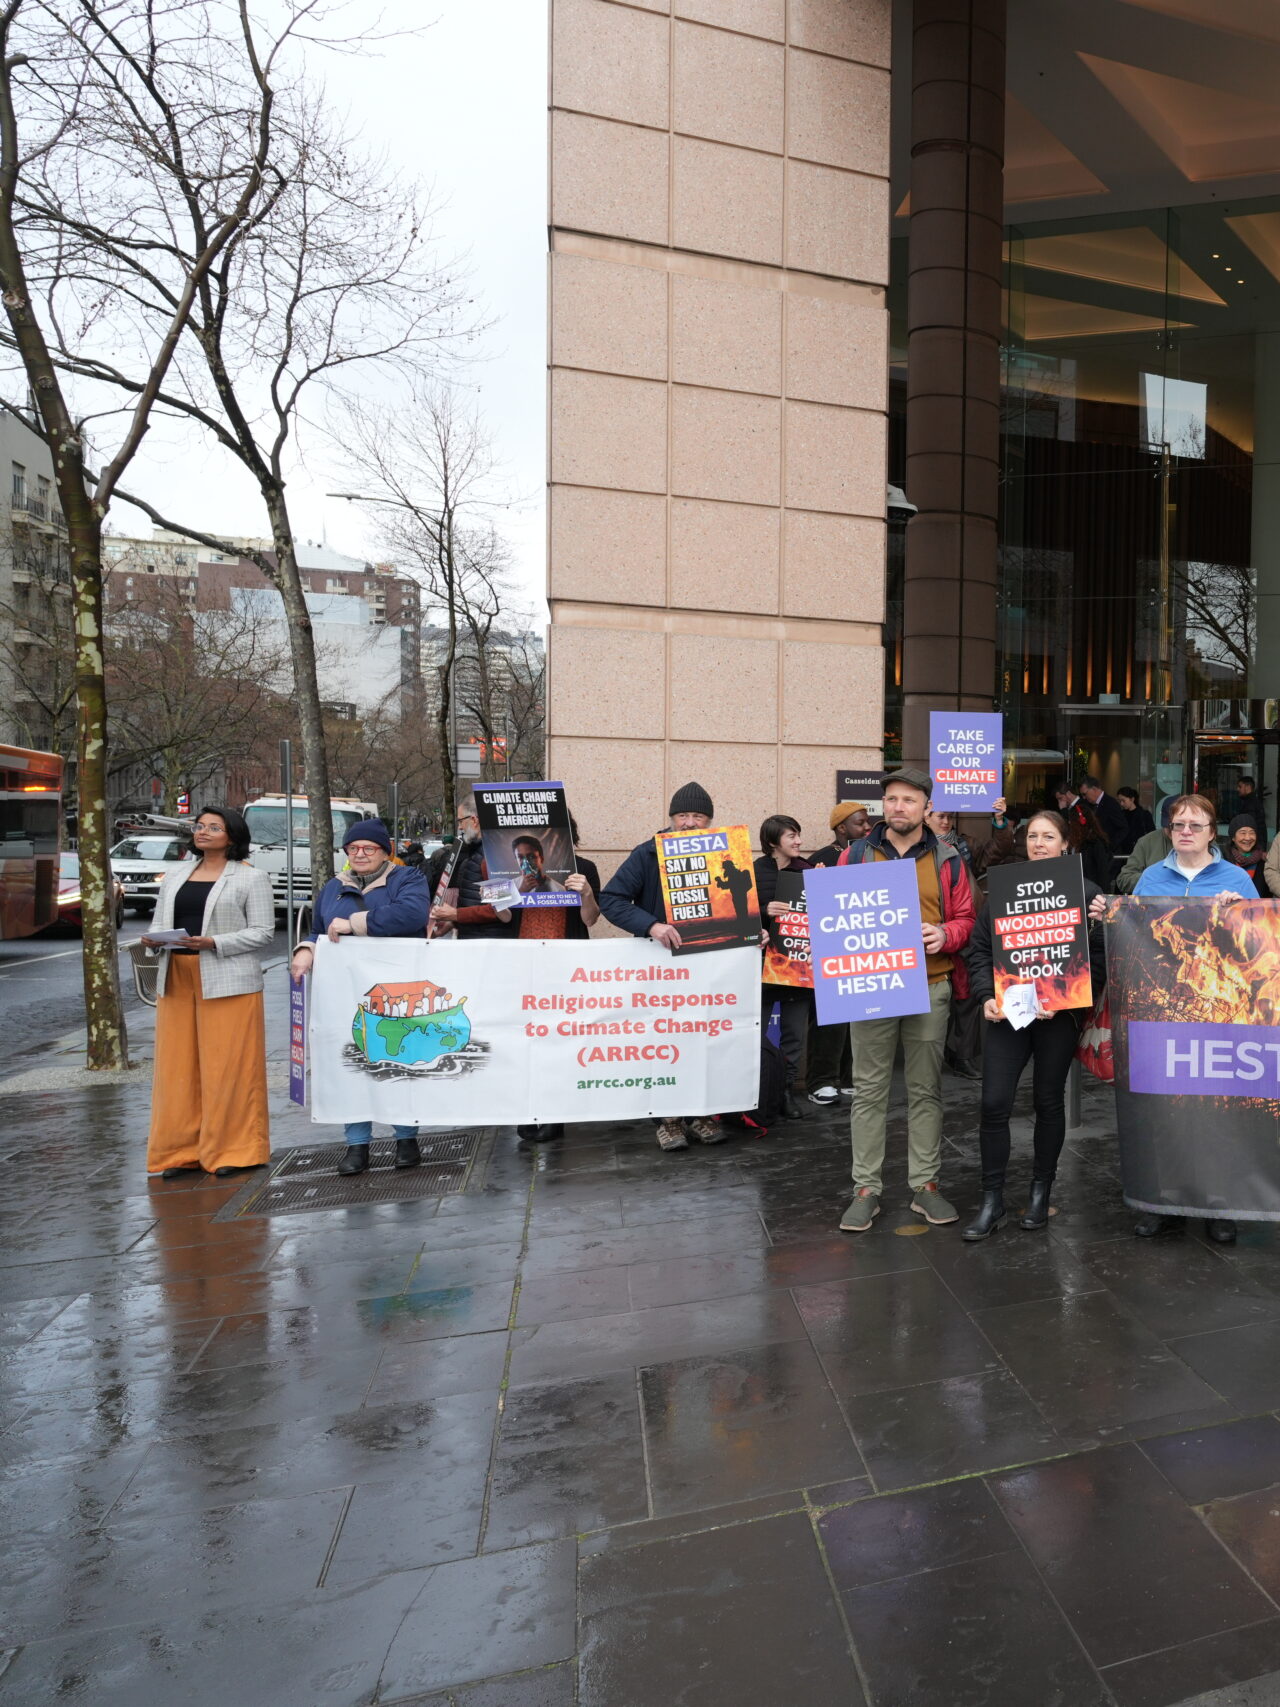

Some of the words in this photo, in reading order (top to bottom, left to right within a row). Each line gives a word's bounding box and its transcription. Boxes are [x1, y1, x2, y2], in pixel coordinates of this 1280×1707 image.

[948, 730, 984, 741] TAKE
[937, 743, 973, 754] CARE
[976, 744, 995, 754] OF
[951, 757, 980, 768] OUR
[936, 770, 996, 781] CLIMATE
[483, 793, 521, 804] CLIMATE
[523, 792, 557, 803] CHANGE
[944, 784, 987, 795] HESTA
[496, 804, 506, 815] IS
[508, 804, 514, 814] A
[515, 803, 548, 814] HEALTH
[498, 815, 549, 826] EMERGENCY
[664, 835, 726, 855] HESTA
[666, 859, 687, 873] SAY
[690, 857, 706, 871] NO
[668, 875, 682, 889] TO
[685, 871, 709, 887] NEW
[1017, 880, 1054, 896] STOP
[670, 889, 708, 905] FOSSIL
[834, 889, 890, 910] TAKE
[1006, 895, 1067, 915] LETTING
[673, 904, 709, 921] FUELS!
[820, 912, 876, 933] CARE
[880, 908, 909, 926] OF
[997, 910, 1078, 932] WOODSIDE
[780, 925, 790, 935] &
[1004, 935, 1014, 948] &
[1016, 927, 1074, 947] SANTOS
[844, 932, 890, 951] OUR
[823, 950, 914, 975] CLIMATE
[1010, 949, 1039, 964] OFF
[1041, 944, 1070, 960] THE
[570, 966, 690, 983] Australian
[1019, 962, 1063, 979] HOOK
[837, 973, 904, 995] HESTA
[522, 994, 623, 1014] Religious
[631, 993, 737, 1012] Response
[525, 1022, 549, 1037] to
[556, 1019, 646, 1036] Climate
[653, 1018, 733, 1037] Change
[577, 1045, 680, 1068] (ARRCC)
[577, 1076, 676, 1090] arrcc.org.au
